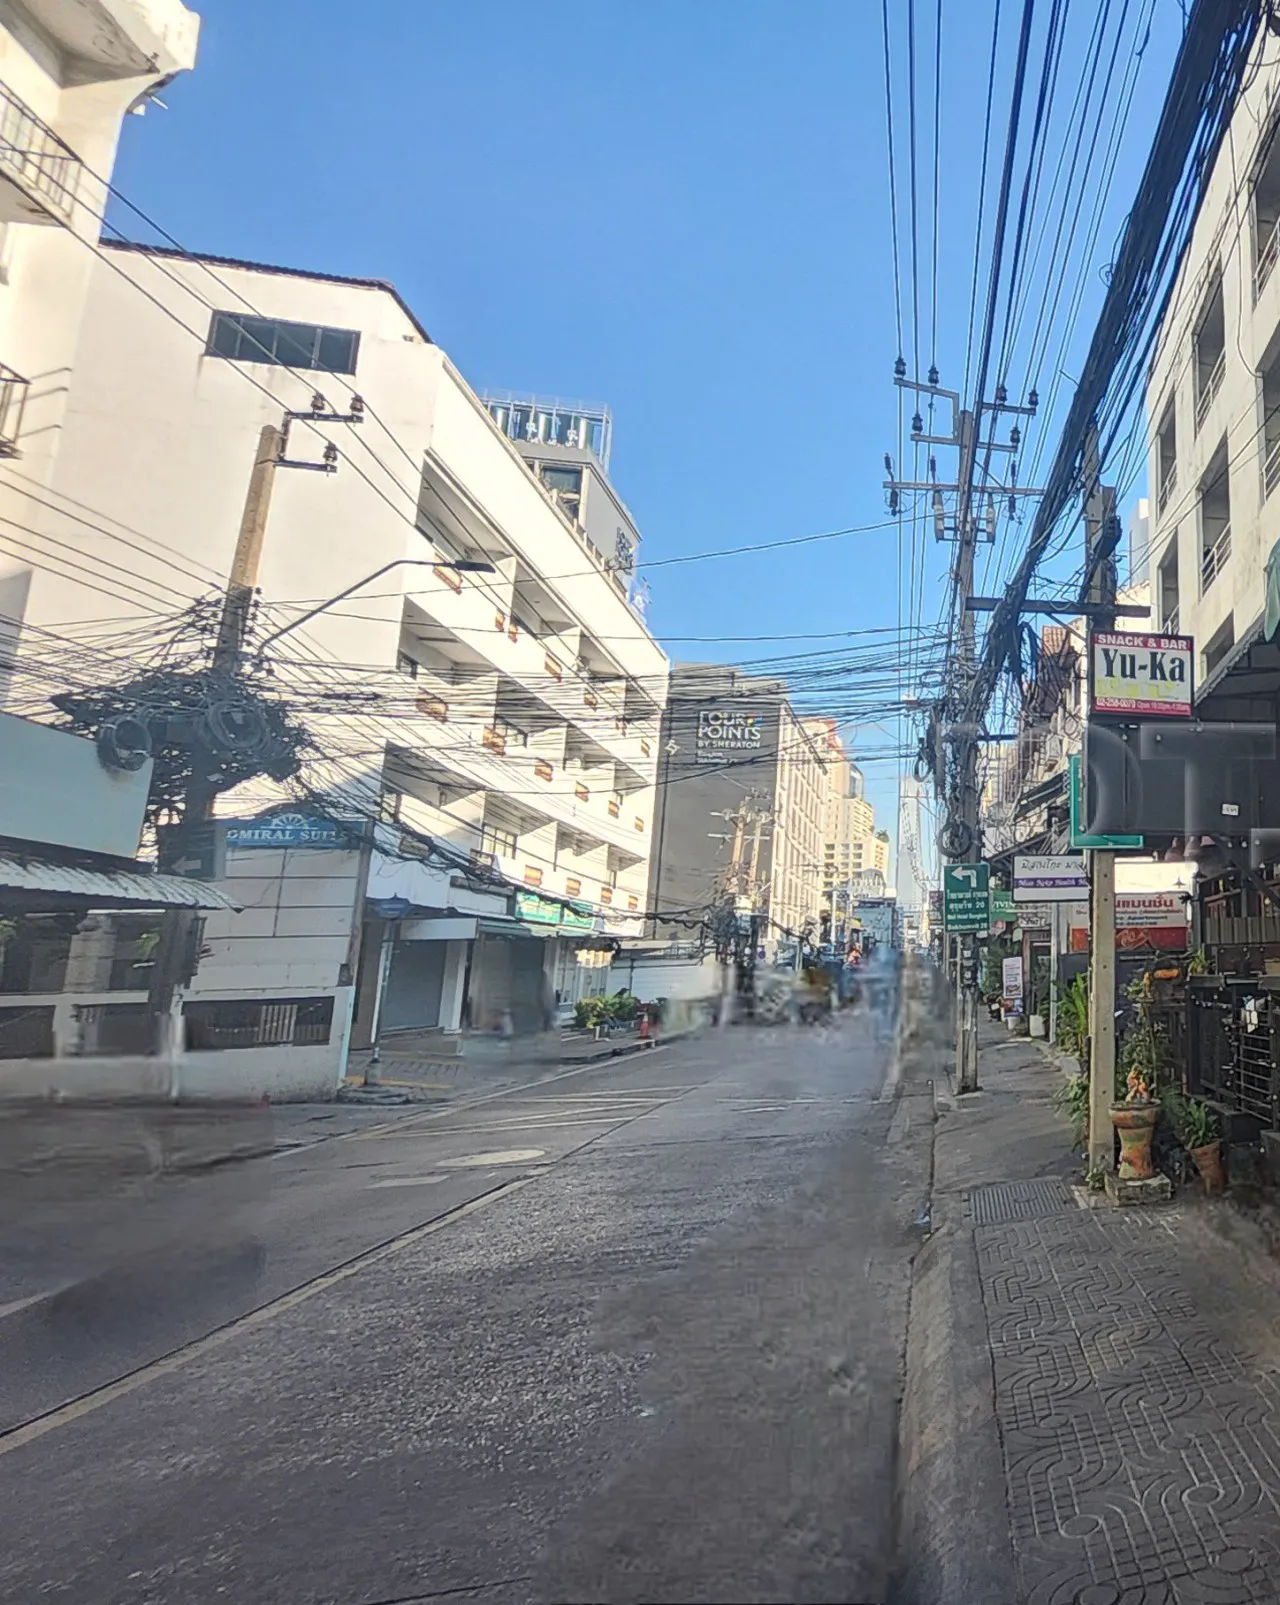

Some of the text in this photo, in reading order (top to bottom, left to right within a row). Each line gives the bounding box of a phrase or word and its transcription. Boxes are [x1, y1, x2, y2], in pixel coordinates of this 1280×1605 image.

[1097, 634, 1188, 650] SNACK & BAR
[1101, 647, 1186, 683] Yu-Ka
[697, 725, 761, 740] POINTS
[712, 740, 761, 748] SHERATON
